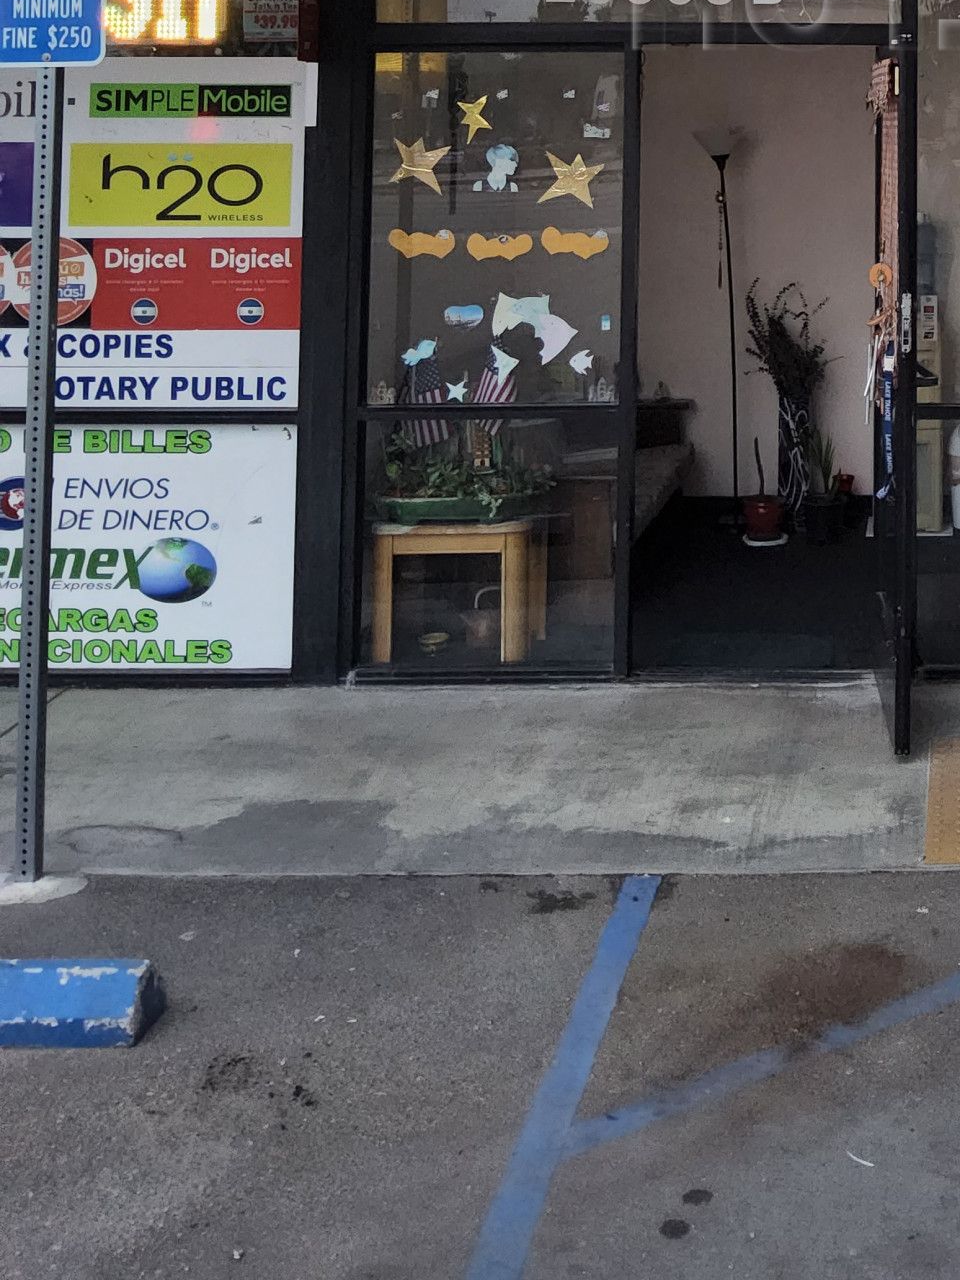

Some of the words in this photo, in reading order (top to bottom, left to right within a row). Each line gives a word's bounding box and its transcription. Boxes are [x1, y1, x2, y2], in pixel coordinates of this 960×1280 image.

[3, 27, 37, 48] FINE
[48, 25, 92, 50] $250
[96, 89, 194, 112] SIMPLE
[203, 88, 288, 113] Mobile
[104, 247, 187, 273] Digicel
[210, 247, 293, 273] Digicel
[57, 333, 174, 359] COPIES
[170, 376, 287, 401] PUBLIC
[84, 429, 213, 454] BILLES
[64, 477, 171, 499] ENVIOS
[57, 509, 95, 531] DE
[102, 509, 210, 531] DINERO
[51, 580, 114, 592] Express
